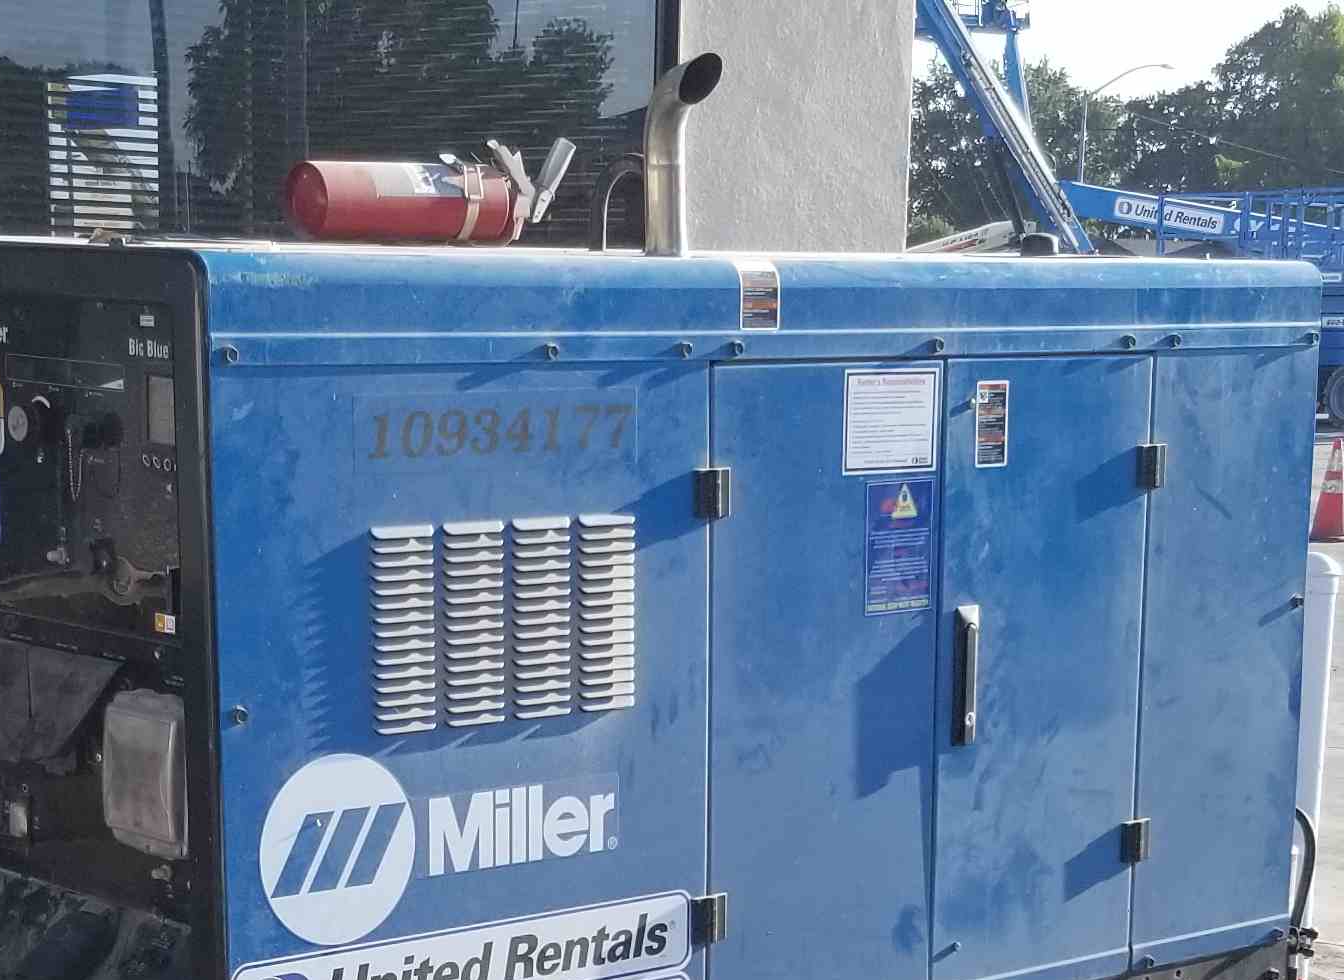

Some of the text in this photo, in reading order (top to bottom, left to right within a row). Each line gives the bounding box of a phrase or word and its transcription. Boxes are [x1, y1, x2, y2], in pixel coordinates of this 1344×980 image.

[1174, 211, 1218, 230] Rentals
[147, 339, 170, 359] Blue
[368, 403, 634, 460] 10934177
[428, 784, 616, 877] Miller
